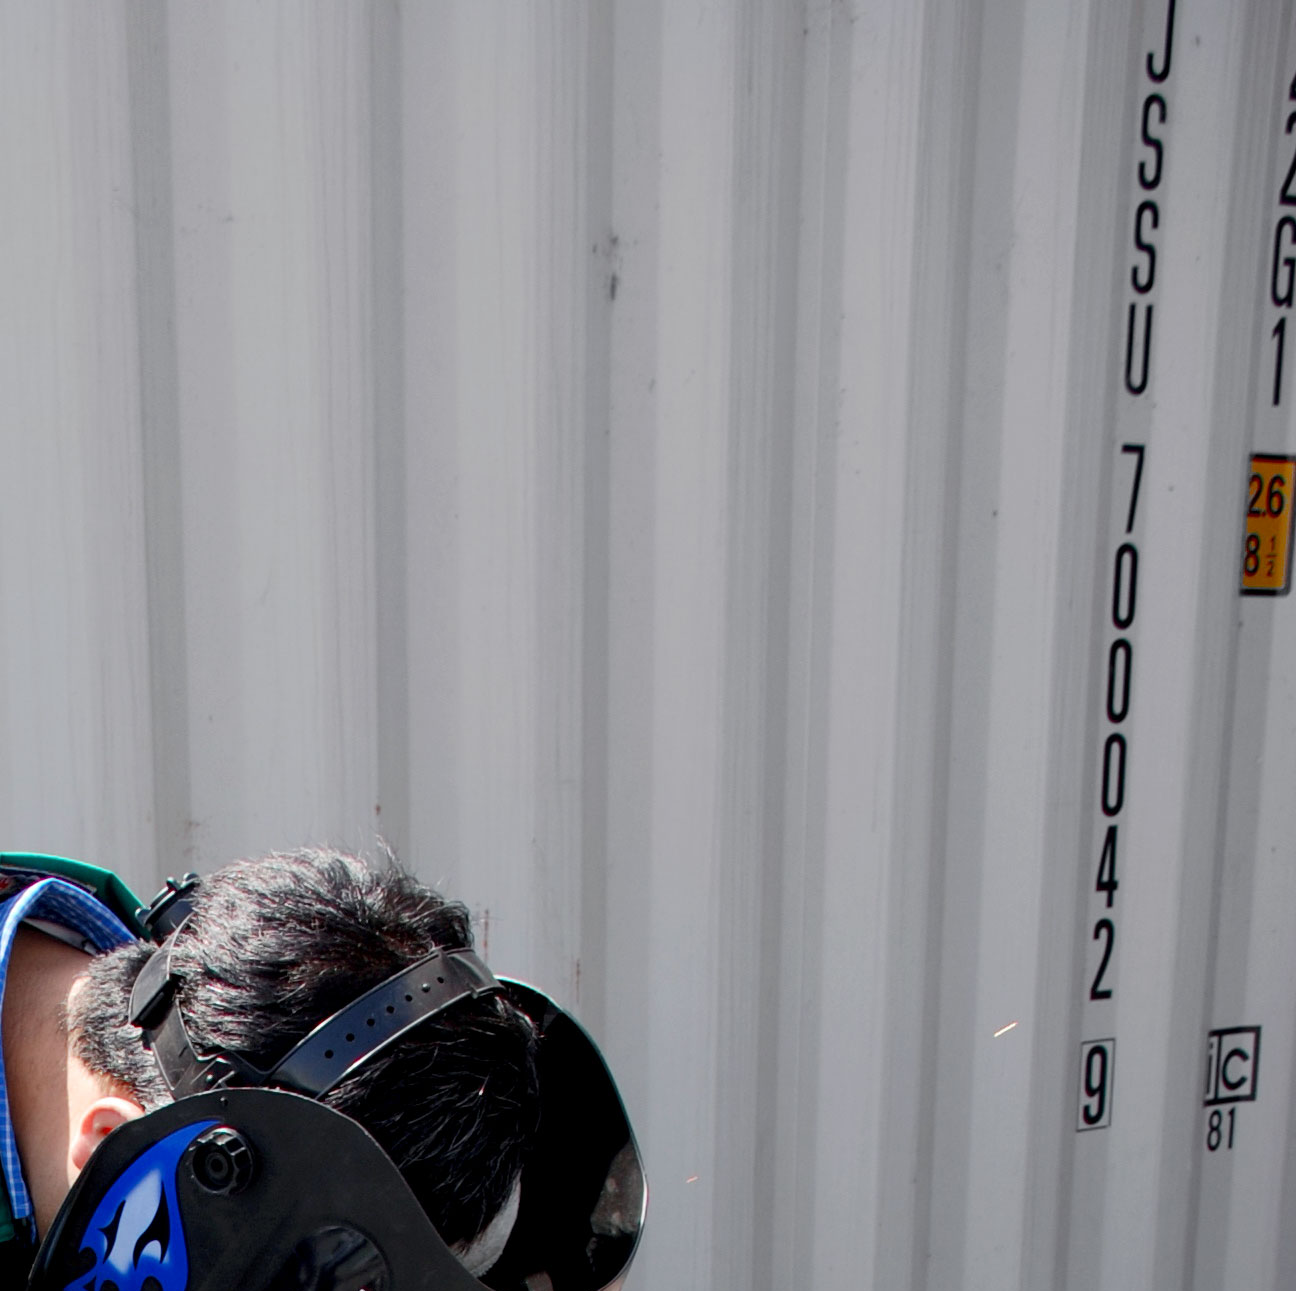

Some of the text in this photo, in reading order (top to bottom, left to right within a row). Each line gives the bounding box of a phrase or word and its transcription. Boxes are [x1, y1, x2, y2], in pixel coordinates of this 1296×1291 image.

[1081, 0, 1176, 1125] JSSU 700042 9
[1207, 1106, 1236, 1152] 81
